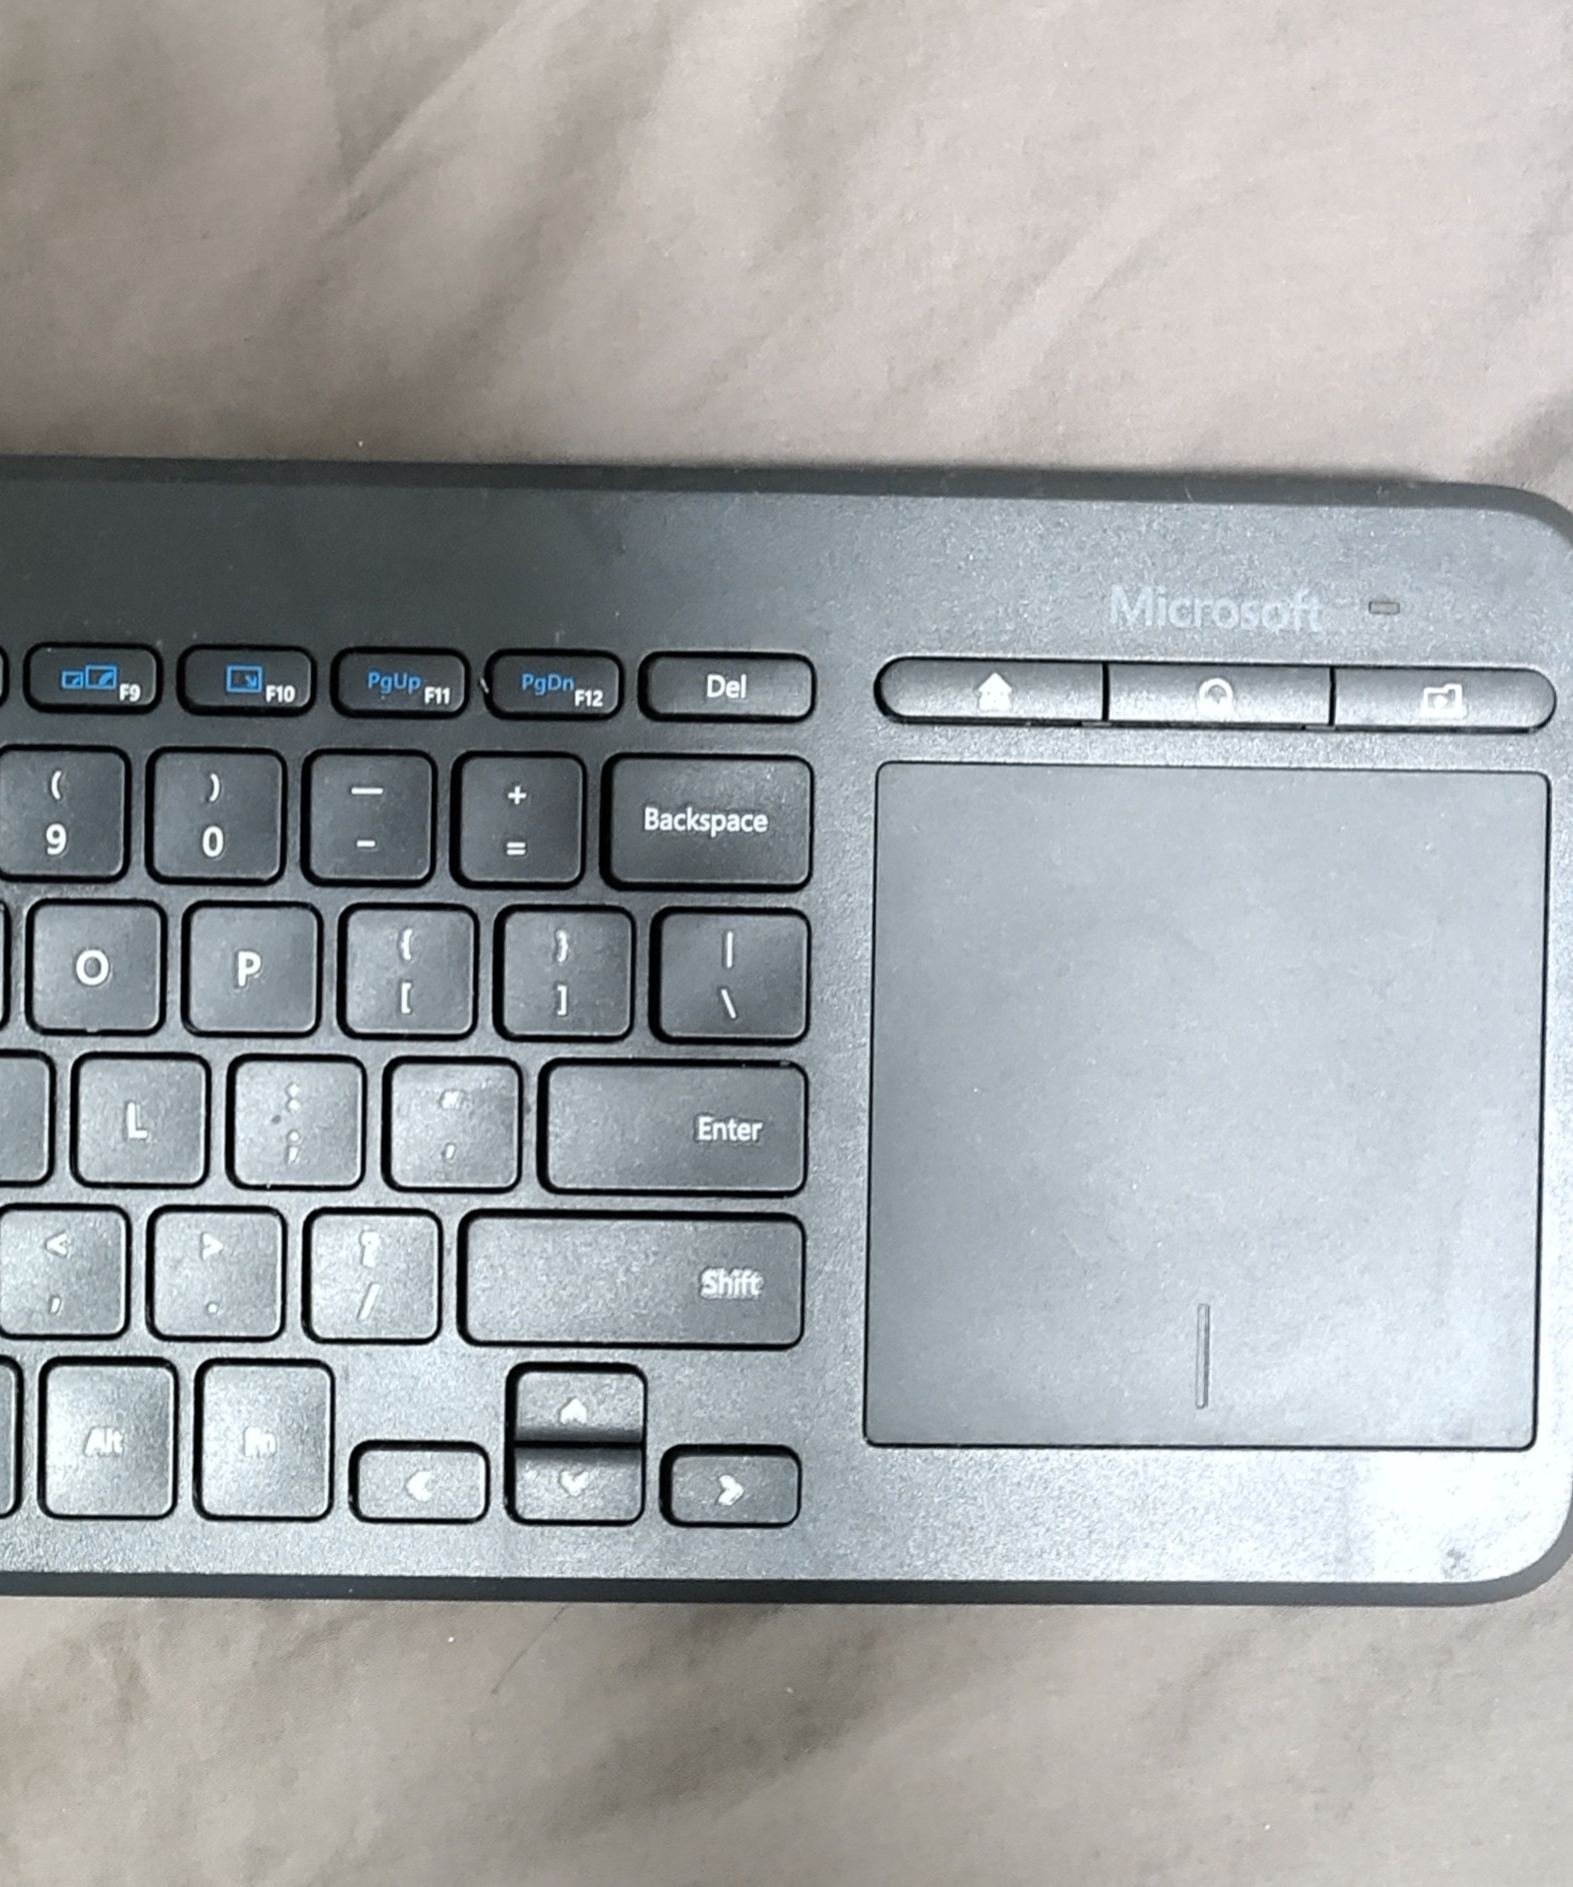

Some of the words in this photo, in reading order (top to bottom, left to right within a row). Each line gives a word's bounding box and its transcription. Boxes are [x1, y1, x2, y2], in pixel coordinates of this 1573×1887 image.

[1110, 585, 1323, 633] Microsoft
[119, 683, 141, 702] F9
[265, 685, 295, 703] F10
[367, 672, 421, 695] PgUp
[424, 687, 450, 705] F11
[521, 672, 574, 696] PgDn
[706, 675, 747, 699] Del
[574, 689, 603, 708] F12
[51, 770, 62, 800] (
[209, 773, 220, 802] )
[507, 785, 527, 805] +
[644, 806, 769, 838] Backspace
[46, 823, 67, 855] 9
[202, 826, 224, 857] 0
[75, 949, 109, 986] O
[237, 951, 261, 986] P
[400, 984, 412, 1014] [
[557, 985, 567, 1016] ]
[721, 989, 736, 1019] \
[127, 1102, 148, 1140] L
[697, 1118, 762, 1143] Enter
[287, 1131, 301, 1163] ;
[45, 1232, 69, 1257] <
[201, 1232, 223, 1259] >
[701, 1269, 763, 1298] Shift
[357, 1284, 380, 1320] /
[85, 1428, 122, 1456] Alt
